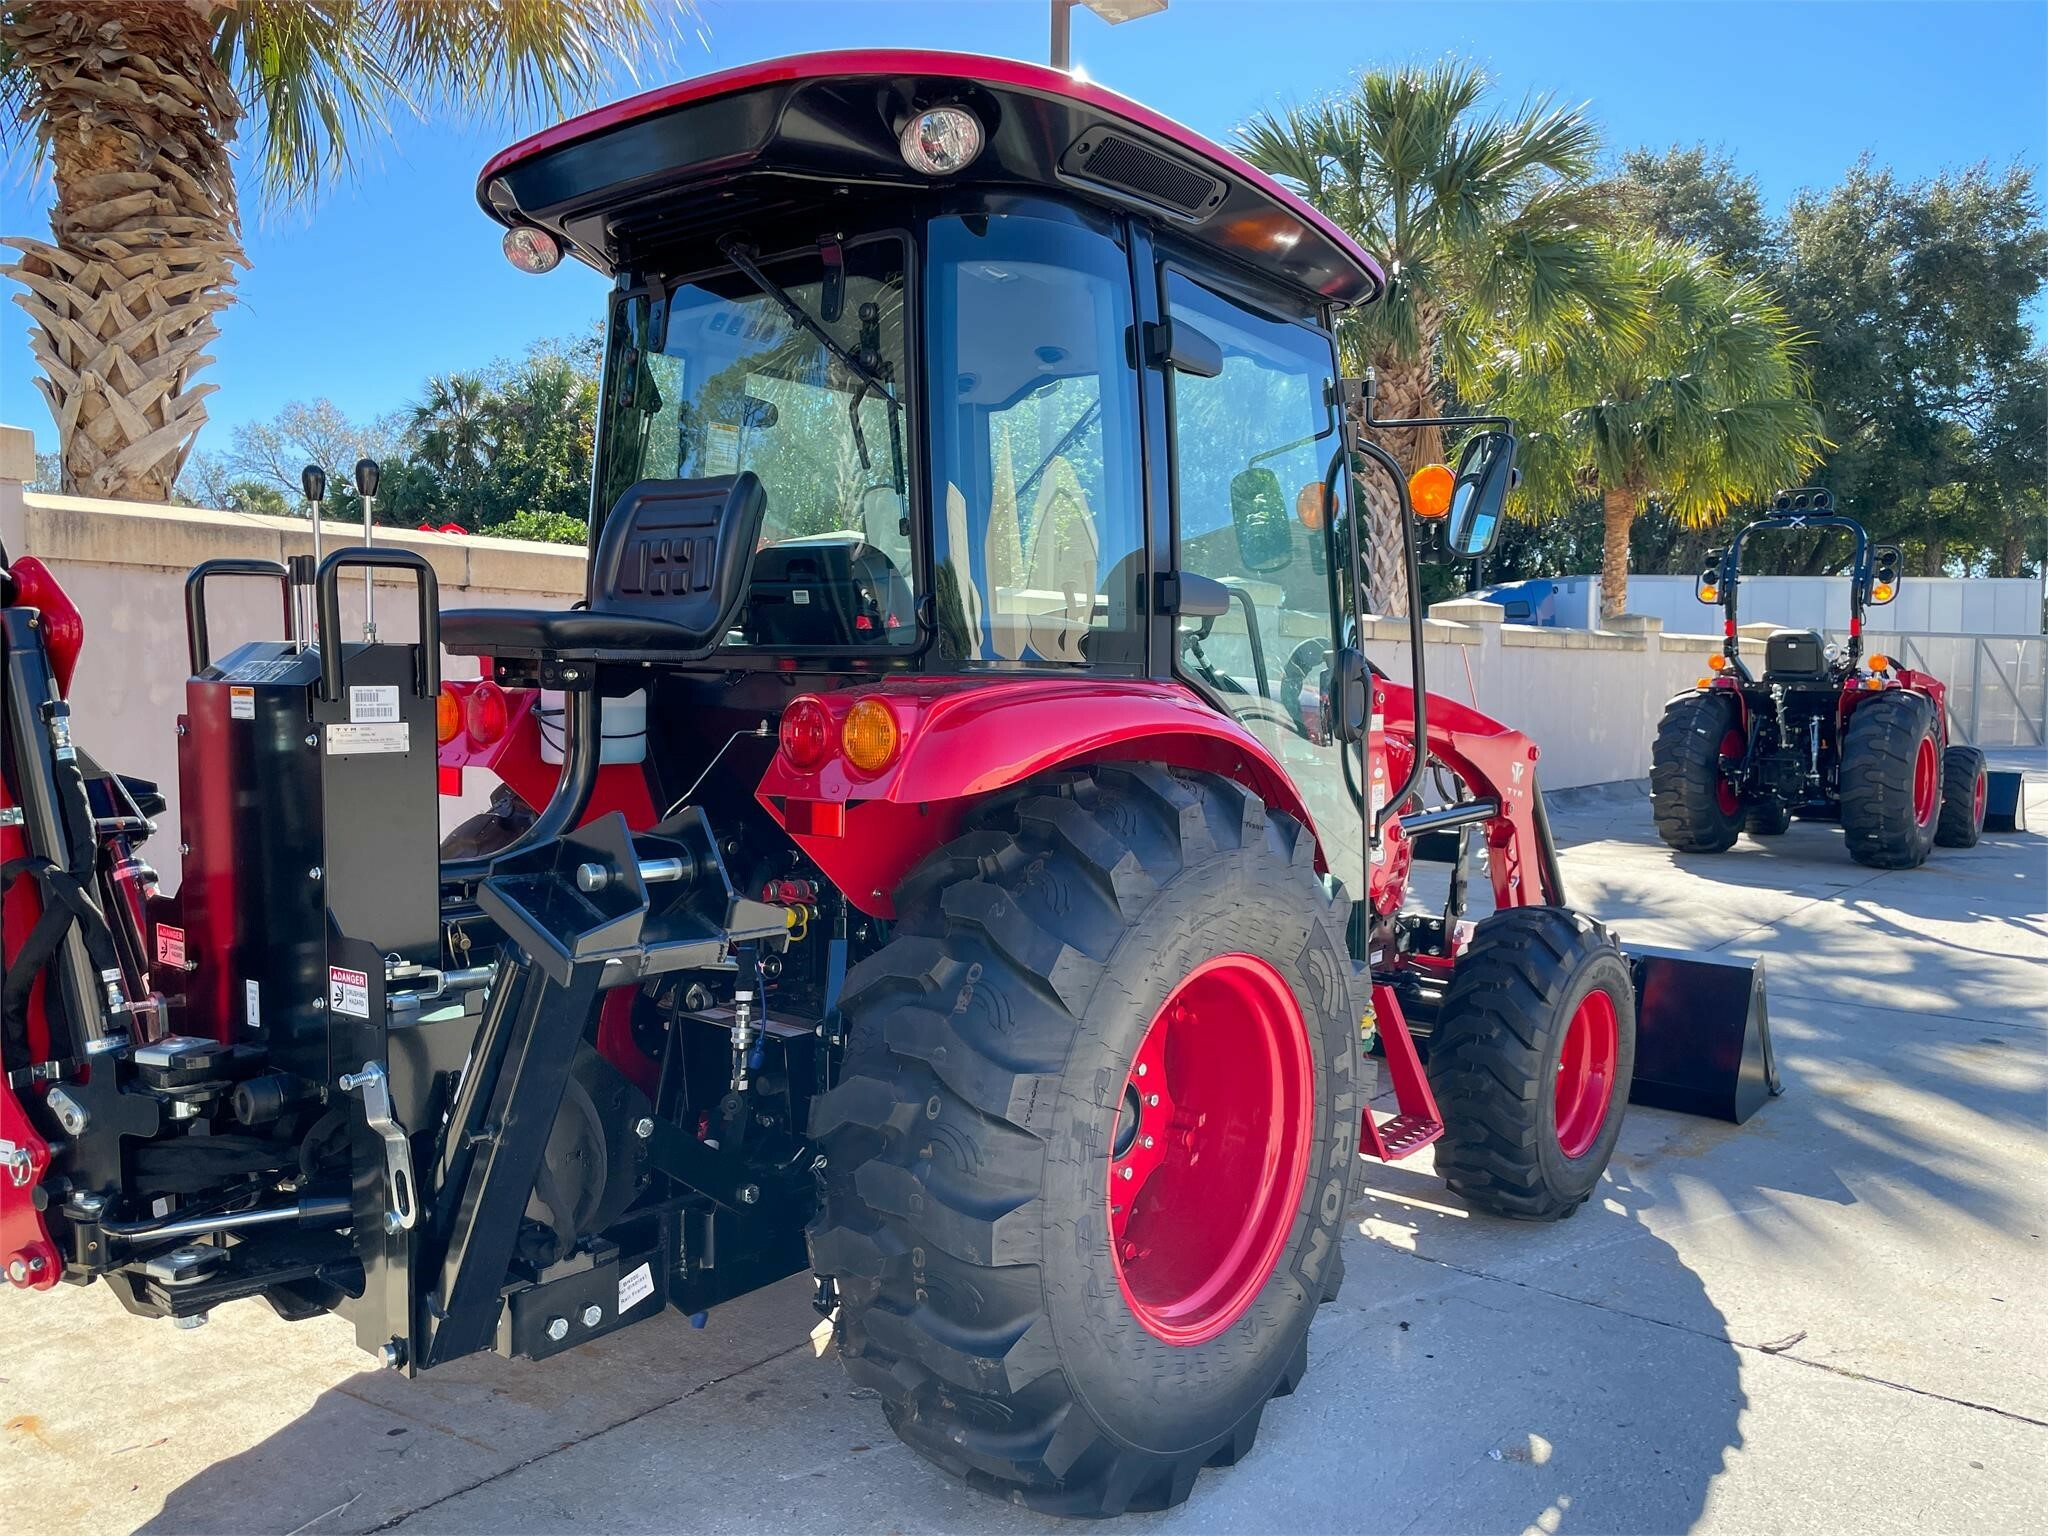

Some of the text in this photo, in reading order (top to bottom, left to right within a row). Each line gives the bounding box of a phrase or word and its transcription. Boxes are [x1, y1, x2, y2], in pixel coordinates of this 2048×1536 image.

[1507, 787, 1523, 798] TYM
[161, 926, 183, 942] DANGER
[337, 971, 365, 986] DANGER
[1299, 1032, 1355, 1284] TIRON
